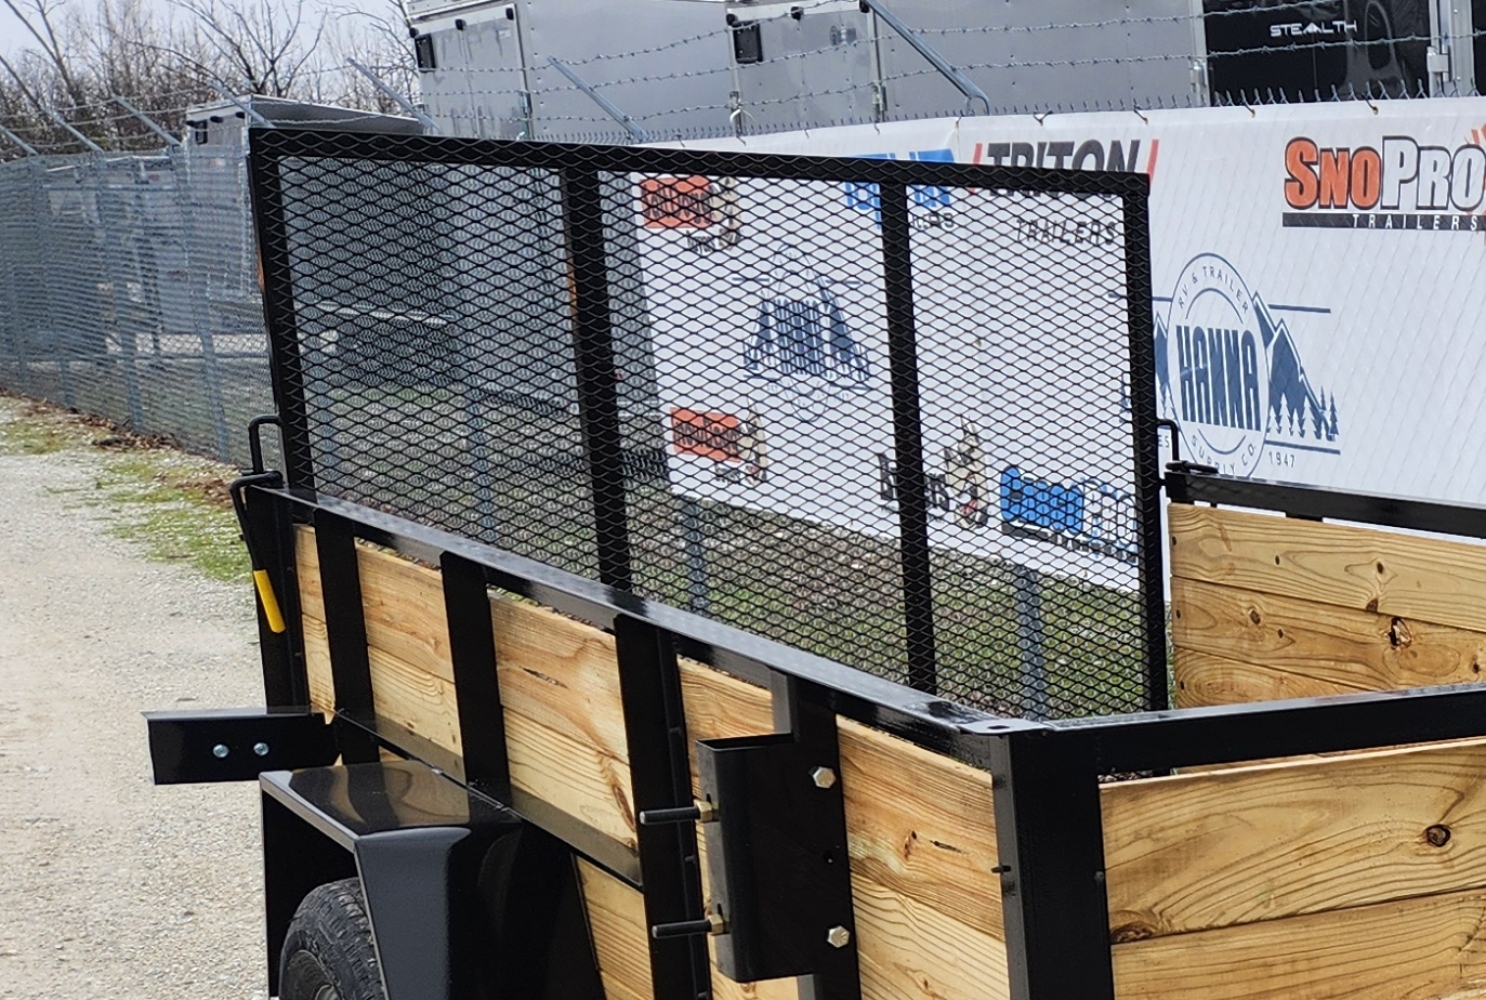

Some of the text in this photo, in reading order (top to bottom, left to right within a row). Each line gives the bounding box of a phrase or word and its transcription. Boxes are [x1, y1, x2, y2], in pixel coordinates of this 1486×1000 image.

[1270, 20, 1357, 37] STEALTH
[987, 139, 1142, 198] TRITON
[1353, 213, 1479, 231] TRAILERS
[1202, 266, 1249, 314] TRAILER
[1176, 325, 1262, 432] HANNA
[1268, 451, 1296, 469] 1947
